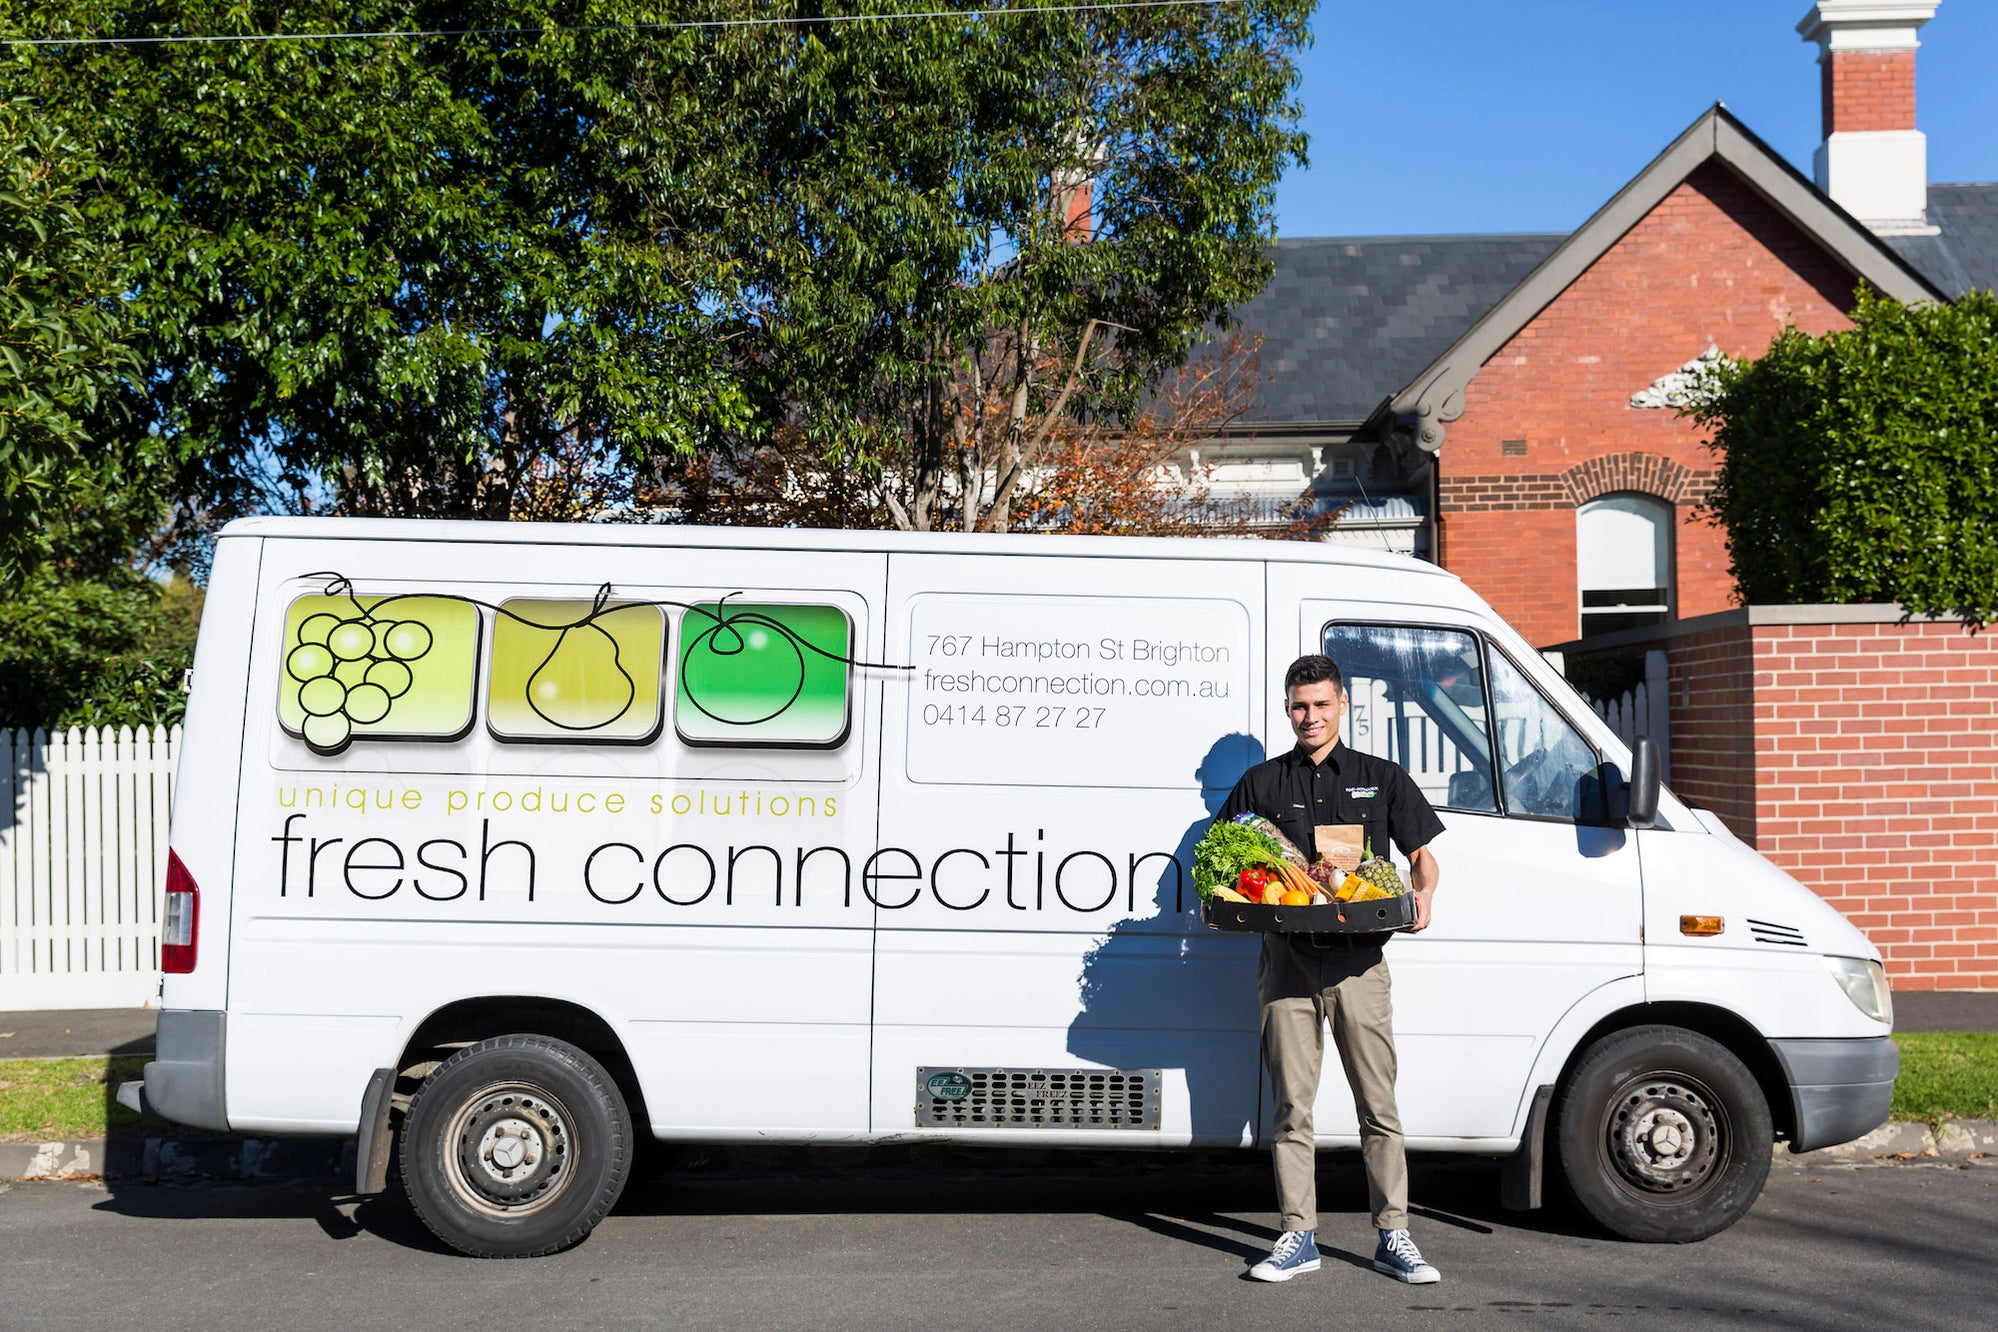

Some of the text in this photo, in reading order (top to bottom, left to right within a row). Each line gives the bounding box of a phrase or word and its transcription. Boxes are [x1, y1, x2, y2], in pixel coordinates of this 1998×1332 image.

[928, 635, 1230, 667] 767 Hampton St Brighton
[924, 669, 1229, 698] freshconnection.com.au
[923, 704, 1106, 729] 0414 87 27 27
[279, 783, 837, 817] unique produce solutions
[271, 814, 1182, 913] fresh connection
[940, 1085, 968, 1096] FREEZ
